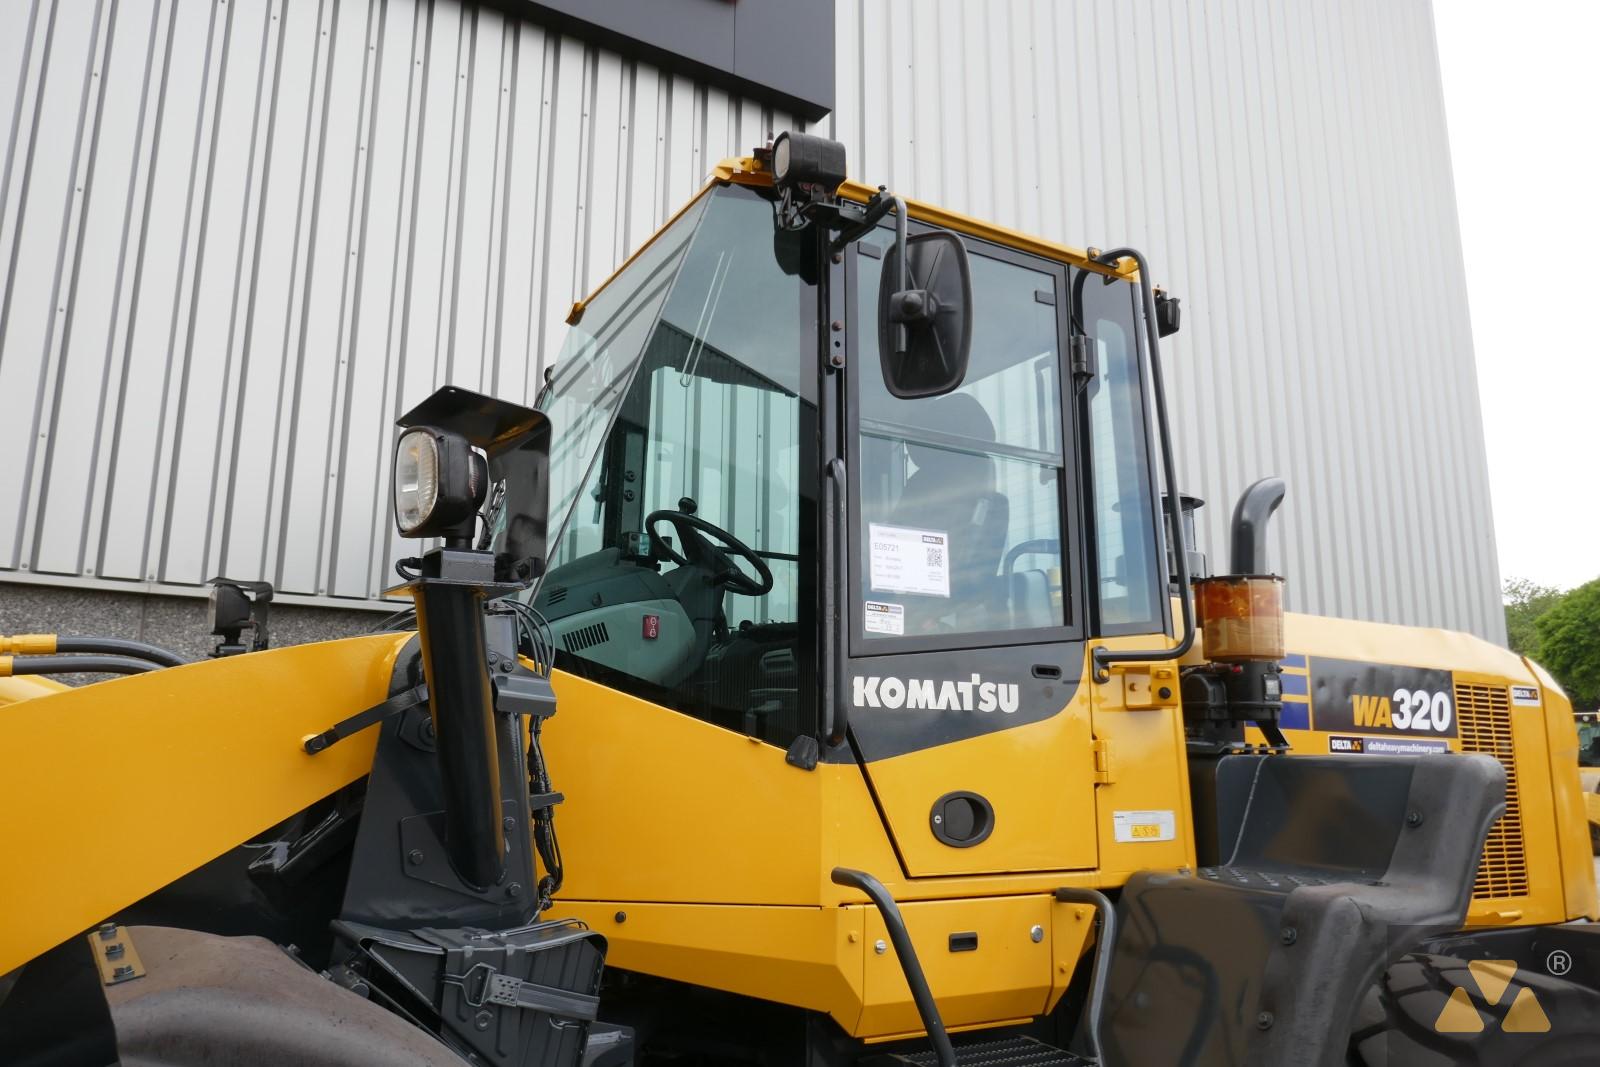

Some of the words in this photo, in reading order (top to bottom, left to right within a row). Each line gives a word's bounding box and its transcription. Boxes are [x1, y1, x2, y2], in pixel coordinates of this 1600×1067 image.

[853, 673, 1019, 713] KOMATSU
[1513, 688, 1530, 698] DELTA
[1352, 688, 1451, 732] WA320
[1331, 739, 1352, 750] DELTA
